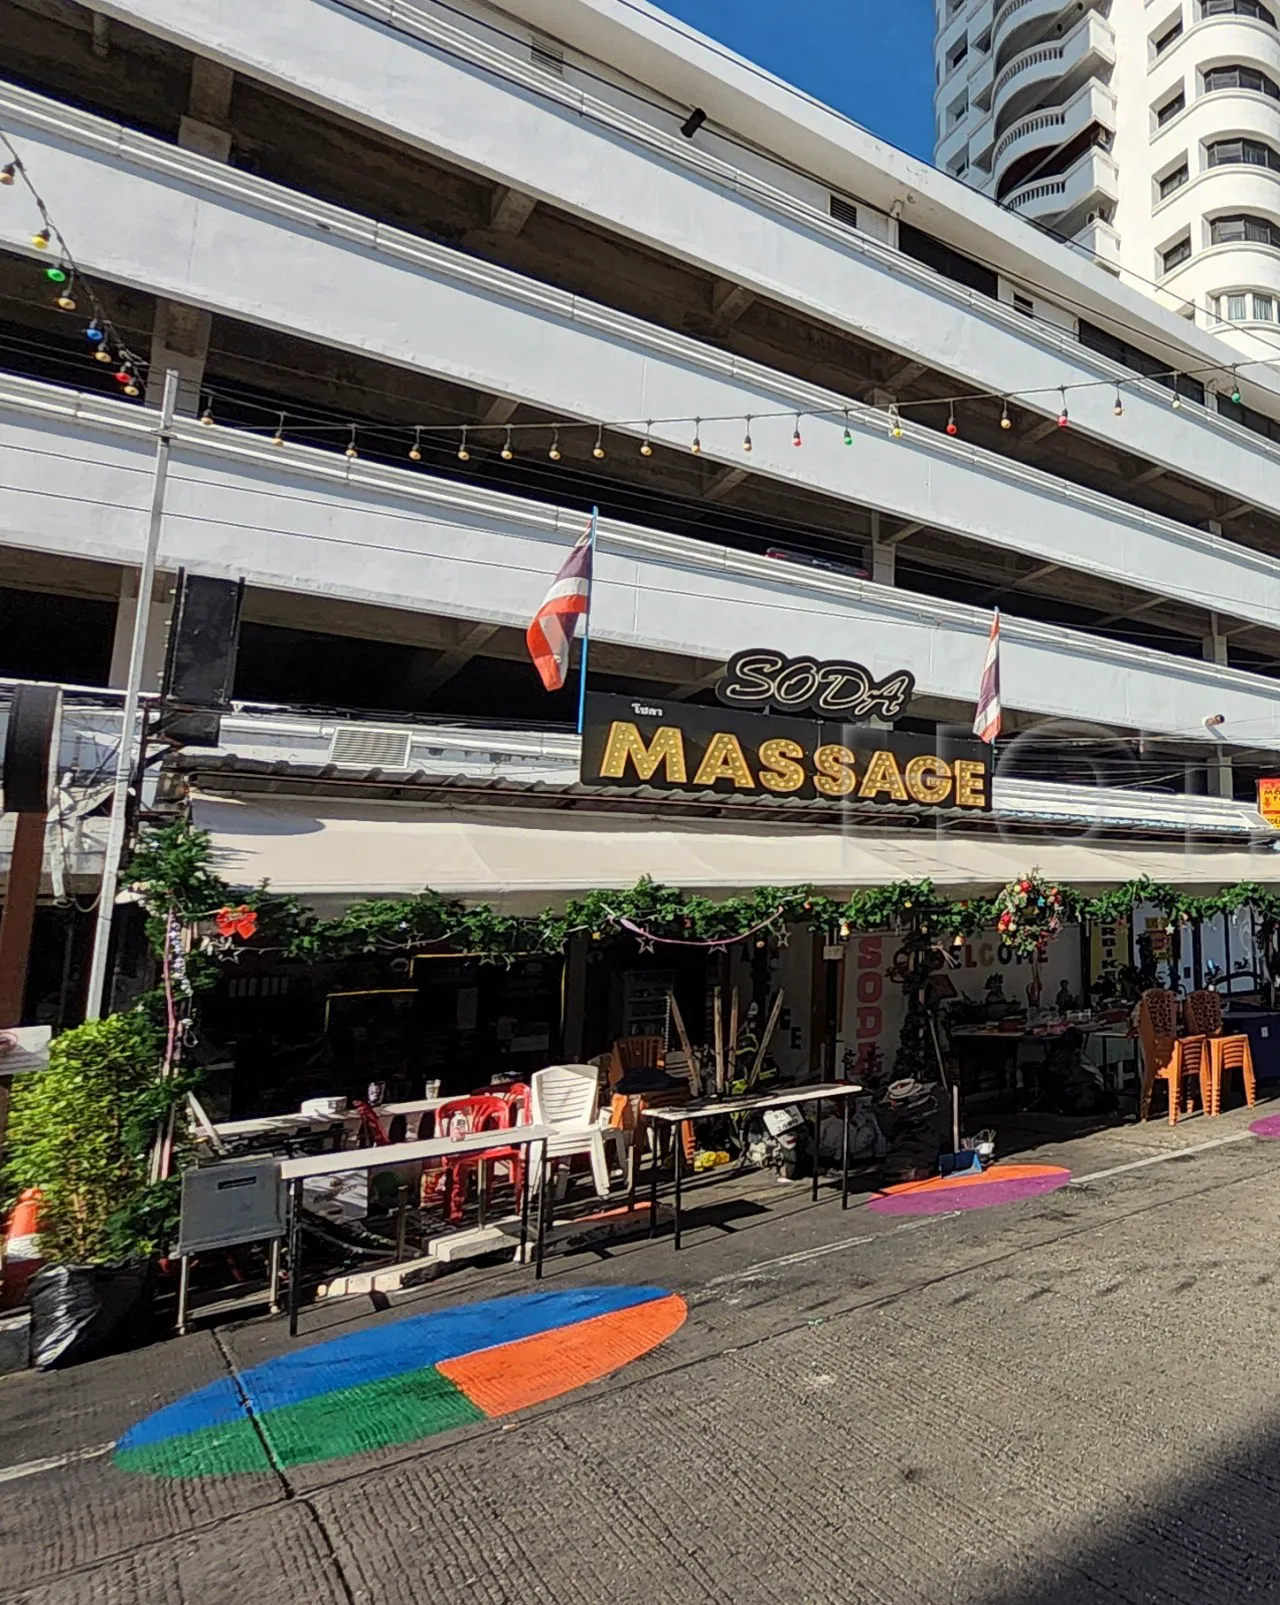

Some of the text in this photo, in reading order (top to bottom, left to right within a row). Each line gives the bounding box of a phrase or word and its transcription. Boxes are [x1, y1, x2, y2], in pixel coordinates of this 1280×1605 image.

[725, 654, 910, 718] SODA
[599, 720, 987, 808] MASSAGE
[933, 941, 1049, 970] ELCOME
